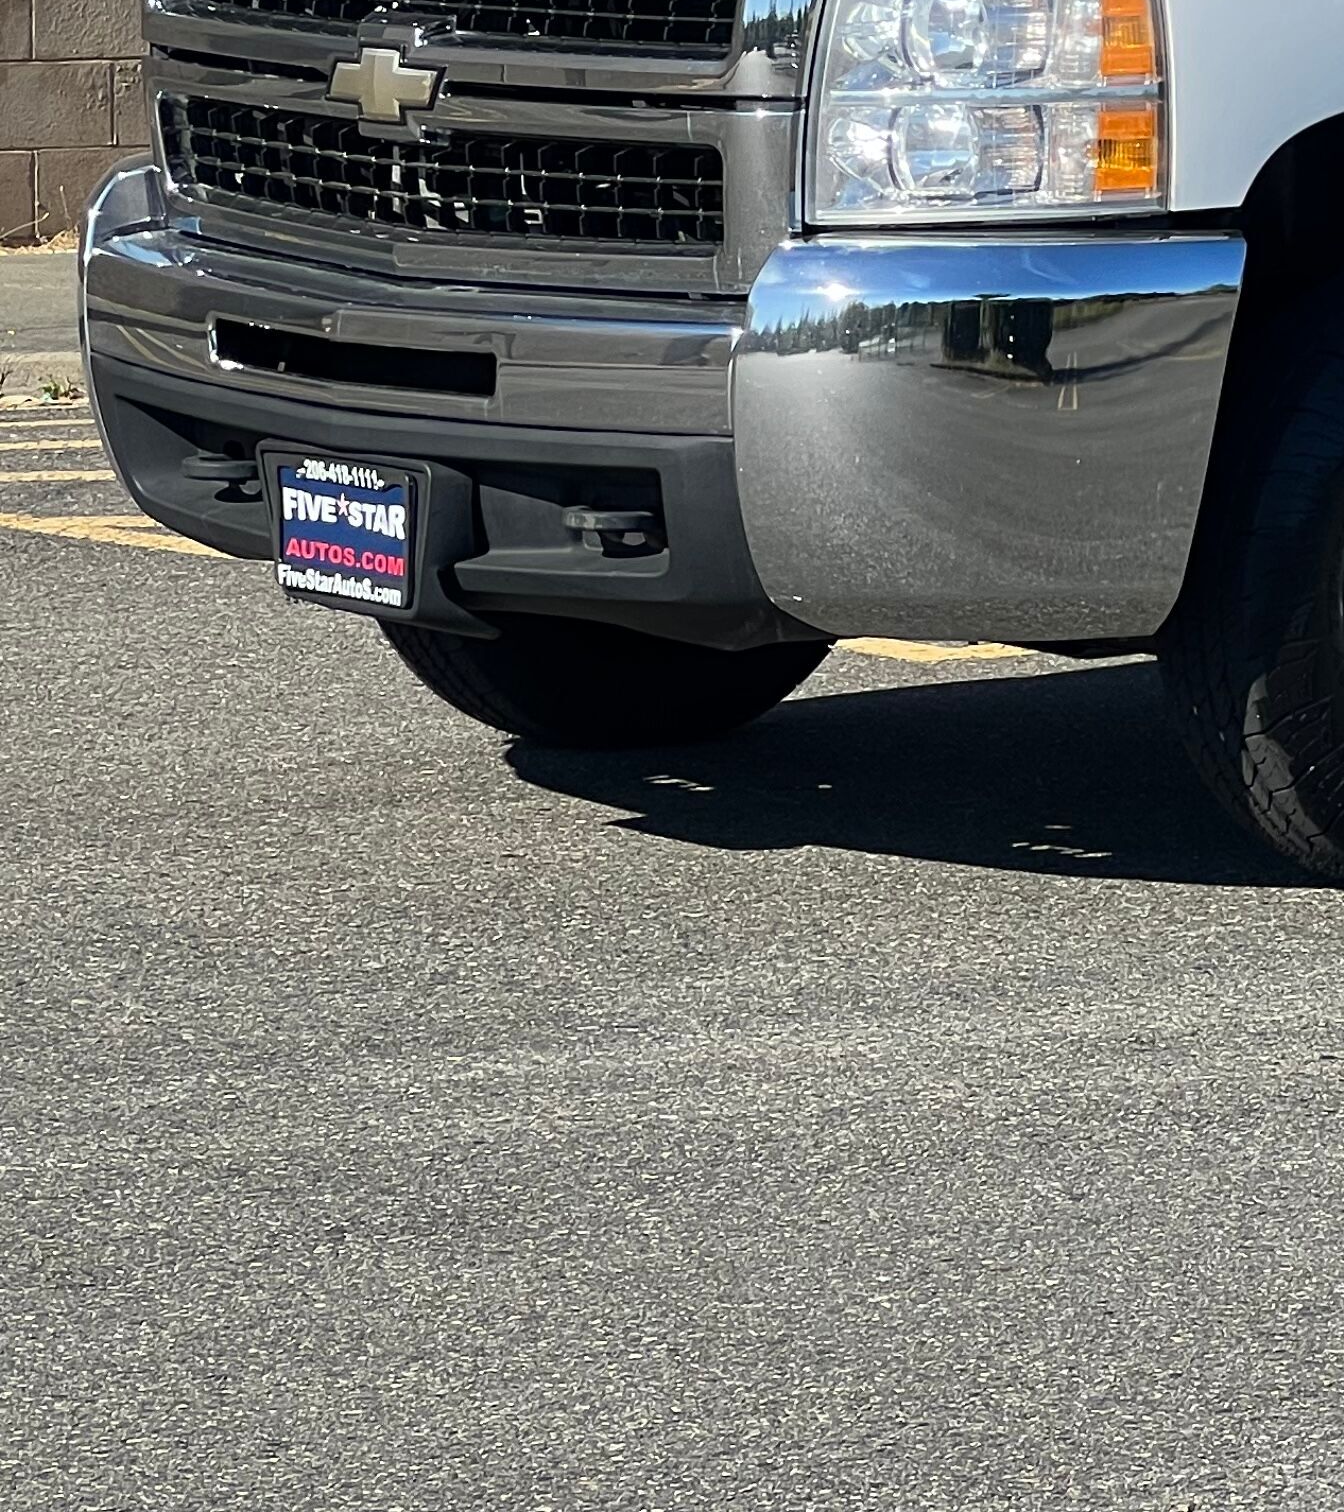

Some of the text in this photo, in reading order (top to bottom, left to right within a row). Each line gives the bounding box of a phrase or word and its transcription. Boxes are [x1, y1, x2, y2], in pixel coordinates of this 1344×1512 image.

[282, 486, 406, 540] FIVE STAR
[286, 537, 405, 576] AUTOS.COM
